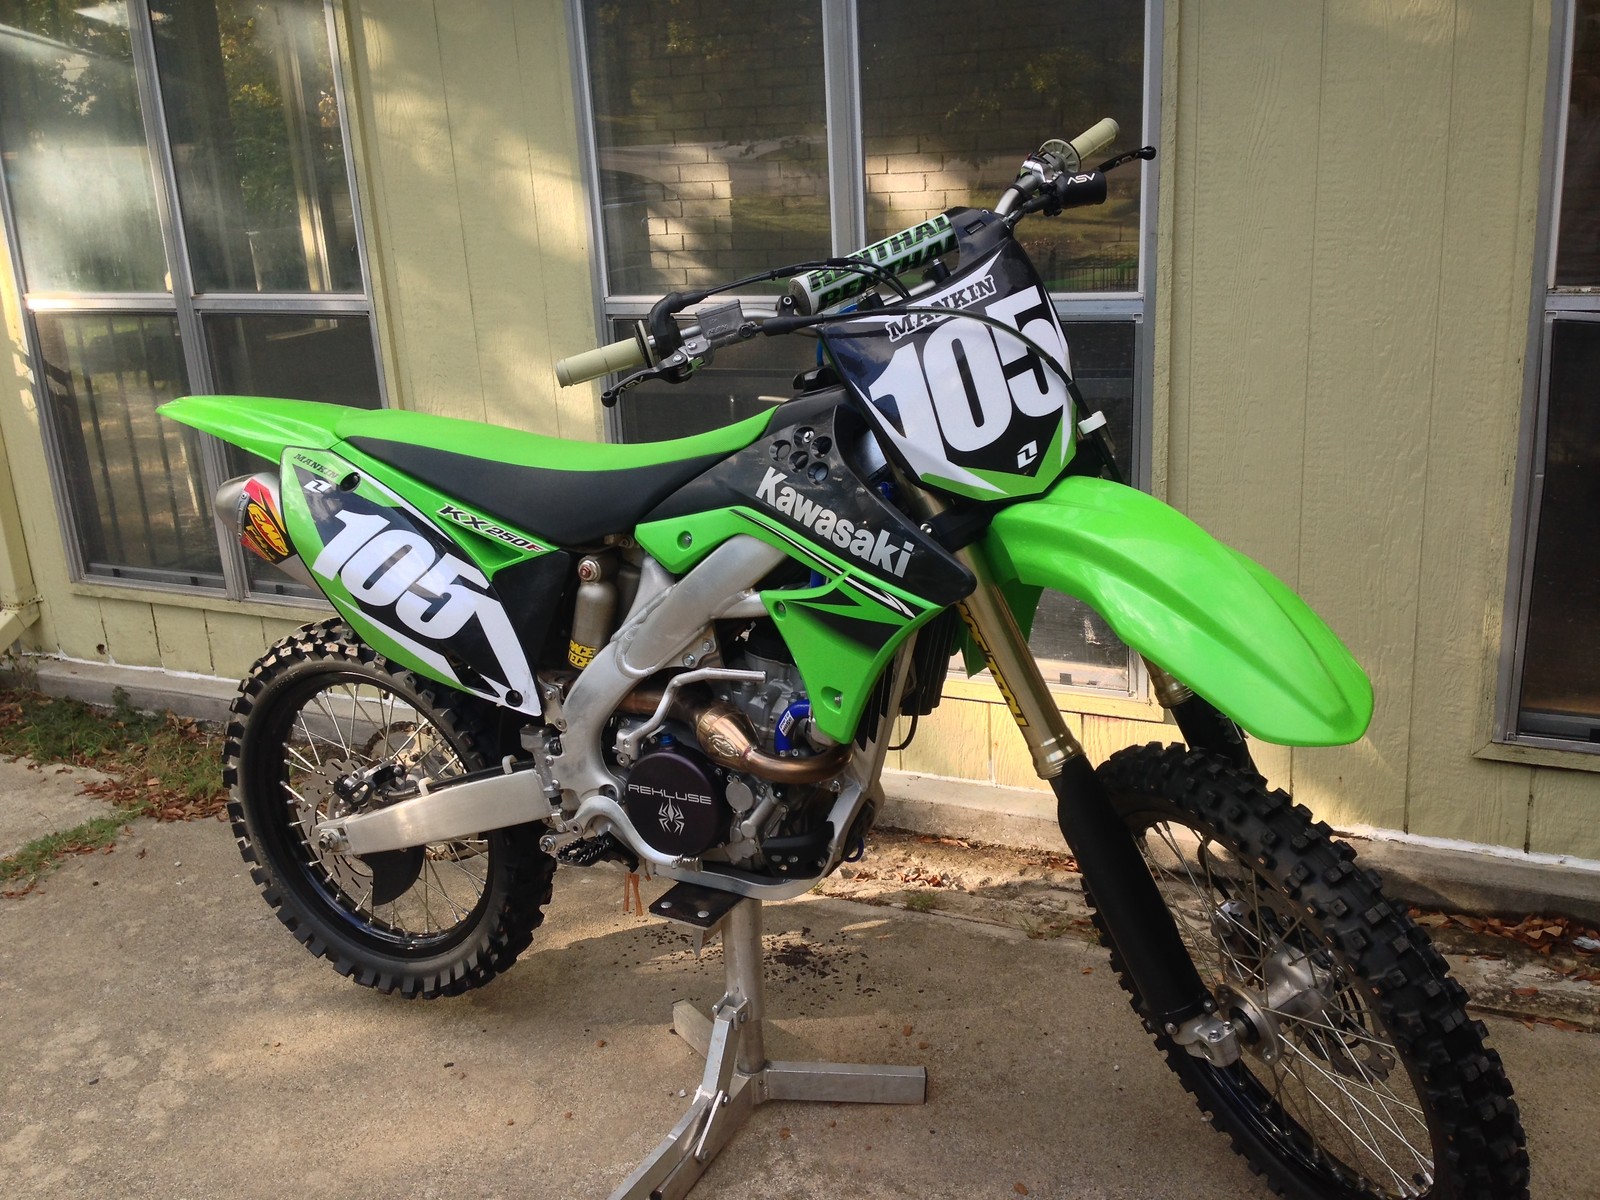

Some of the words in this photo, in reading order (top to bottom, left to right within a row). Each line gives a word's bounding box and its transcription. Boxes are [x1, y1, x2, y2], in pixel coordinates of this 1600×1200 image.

[1067, 173, 1095, 185] ASV
[868, 285, 1066, 456] 105
[312, 509, 490, 640] 105
[755, 466, 915, 578] Kawasaki
[628, 783, 712, 805] REKLUSE
